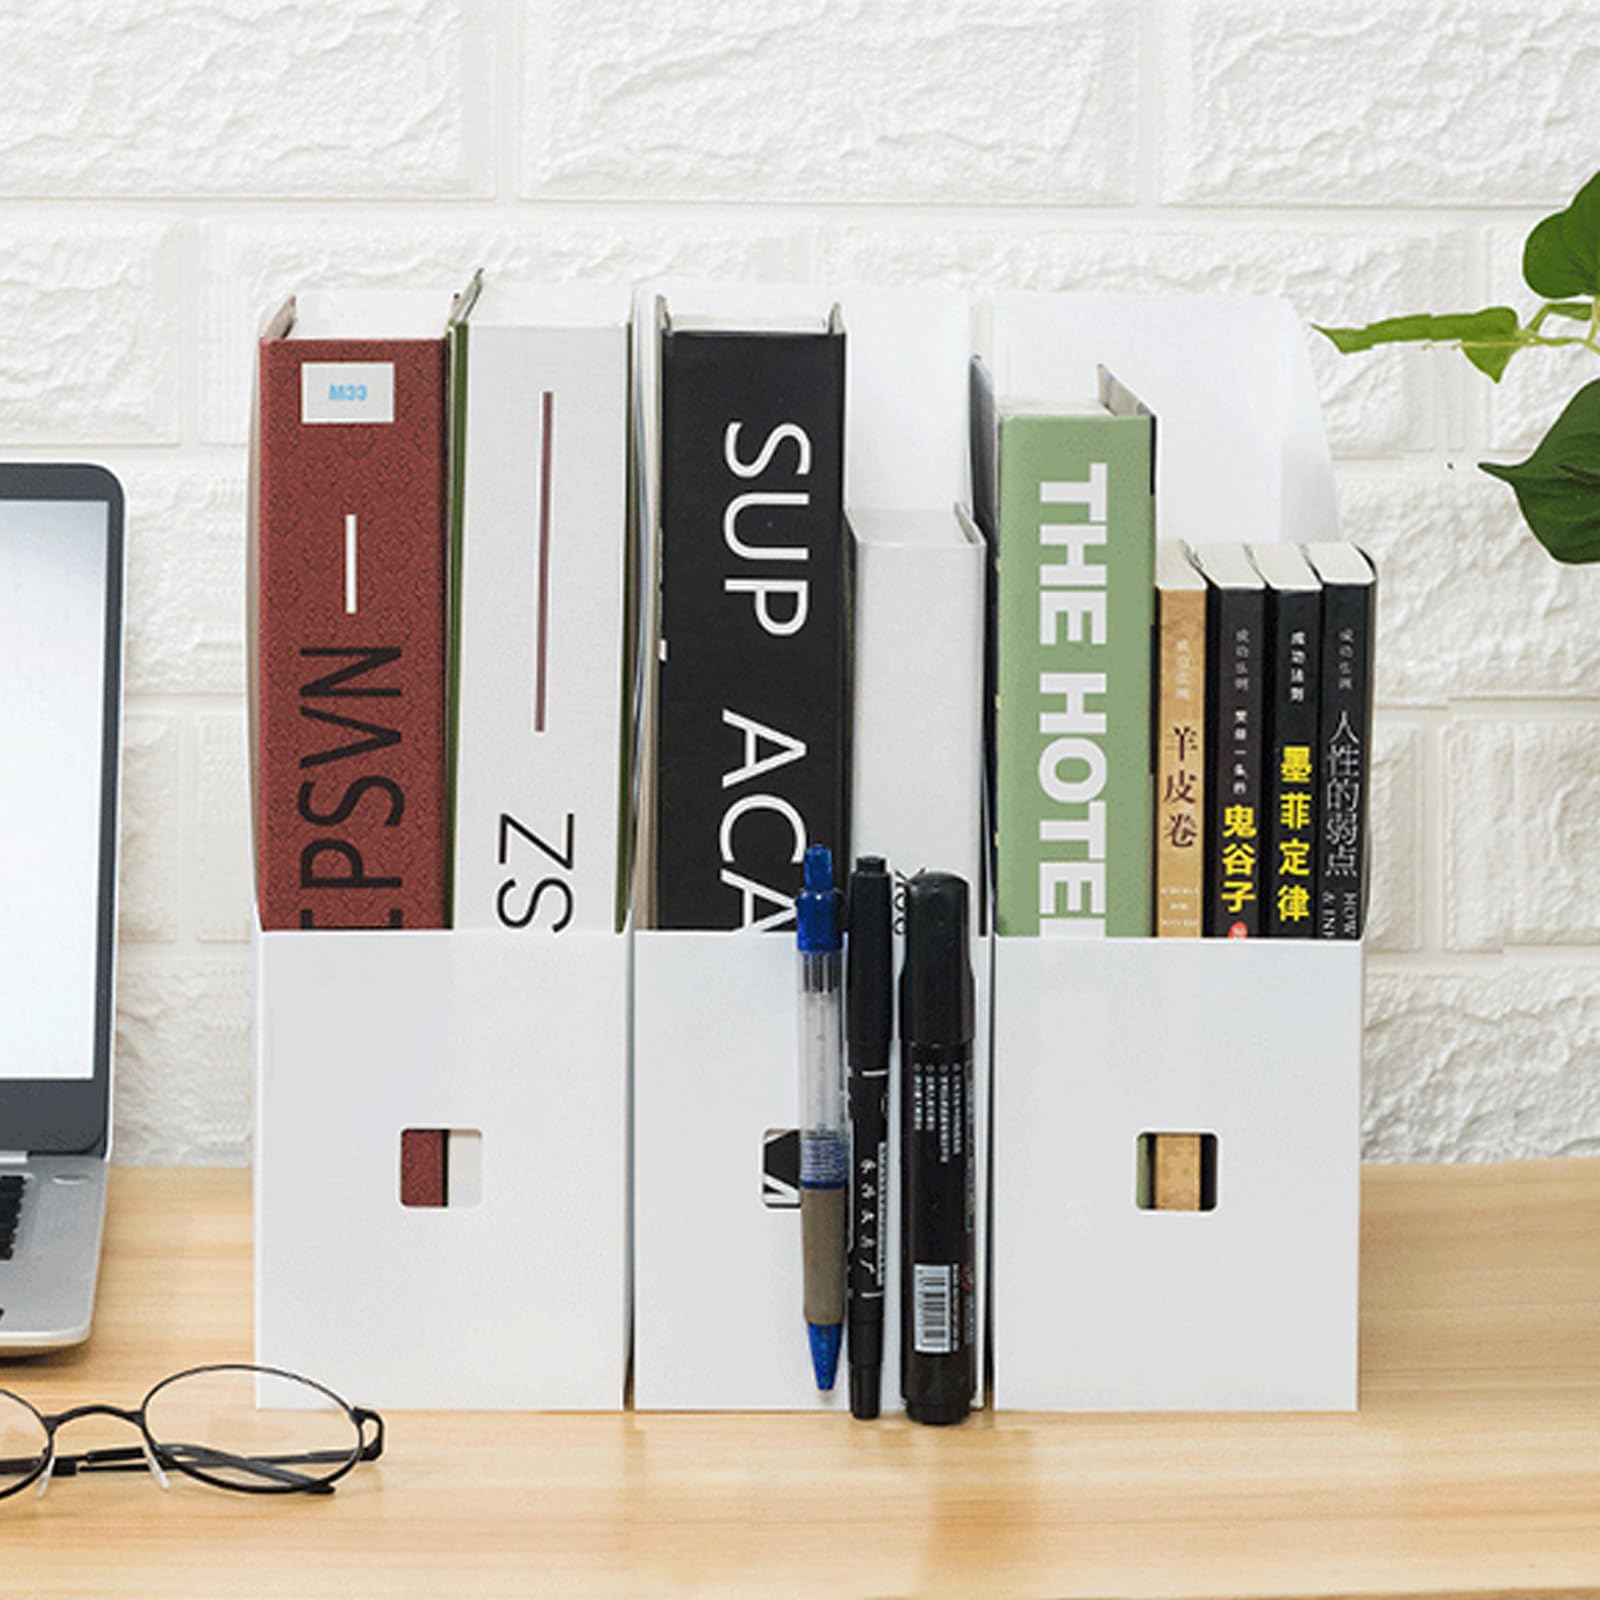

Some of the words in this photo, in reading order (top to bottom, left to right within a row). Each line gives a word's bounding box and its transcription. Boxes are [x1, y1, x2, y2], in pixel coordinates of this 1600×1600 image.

[722, 421, 812, 637] SUP
[1040, 463, 1107, 644] THE
[1163, 726, 1198, 847] 羊皮卷
[1222, 804, 1257, 913] 鬼谷子
[1277, 745, 1312, 922] 墨菲定律
[1325, 710, 1360, 877] 人性的弱点
